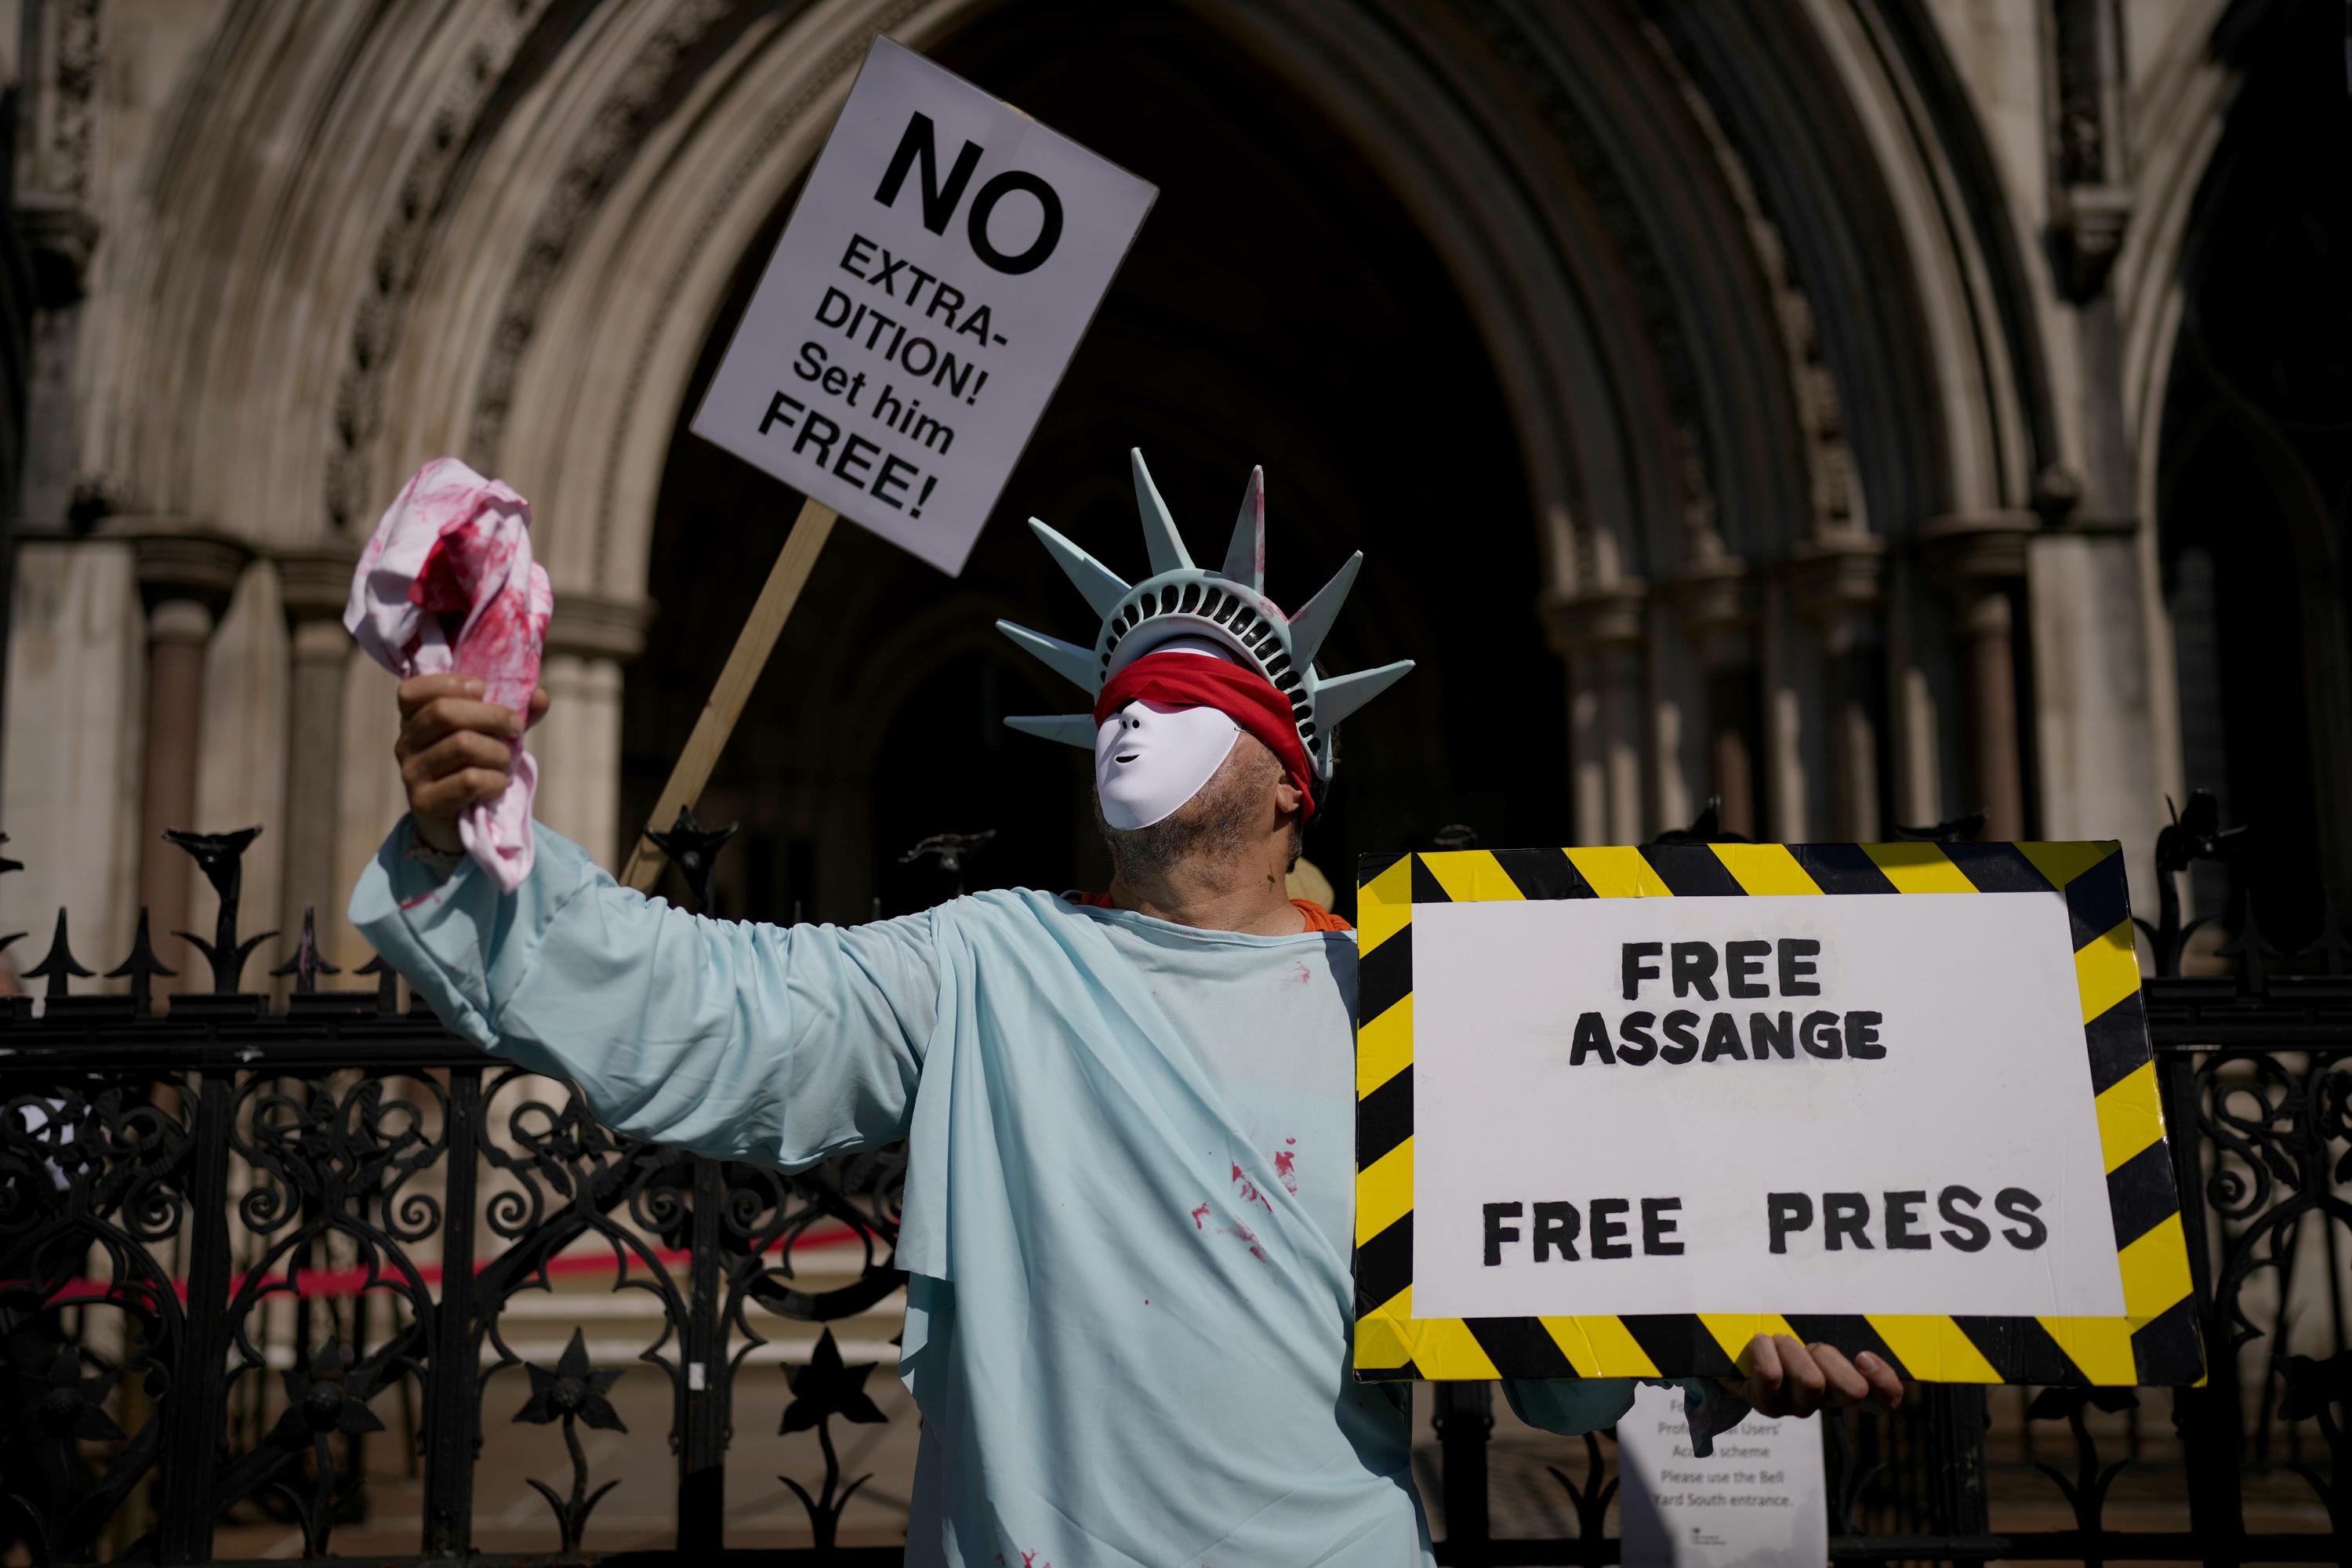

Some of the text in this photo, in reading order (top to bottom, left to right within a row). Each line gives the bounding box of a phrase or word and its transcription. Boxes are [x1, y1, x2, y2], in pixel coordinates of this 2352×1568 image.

[872, 110, 1064, 276] NO
[838, 233, 1009, 349] EXTRA-
[814, 285, 990, 407] DITION!
[792, 340, 956, 456] Set him
[757, 389, 939, 521] FREE!
[1621, 937, 1822, 1003] FREE
[1568, 1008, 1888, 1068] ASSANGE
[1482, 1184, 2049, 1268] FREE PRESS
[1660, 1469, 1785, 1484] Please use the Bell
[1719, 1444, 1770, 1458] scheme
[1686, 1492, 1727, 1507] South
